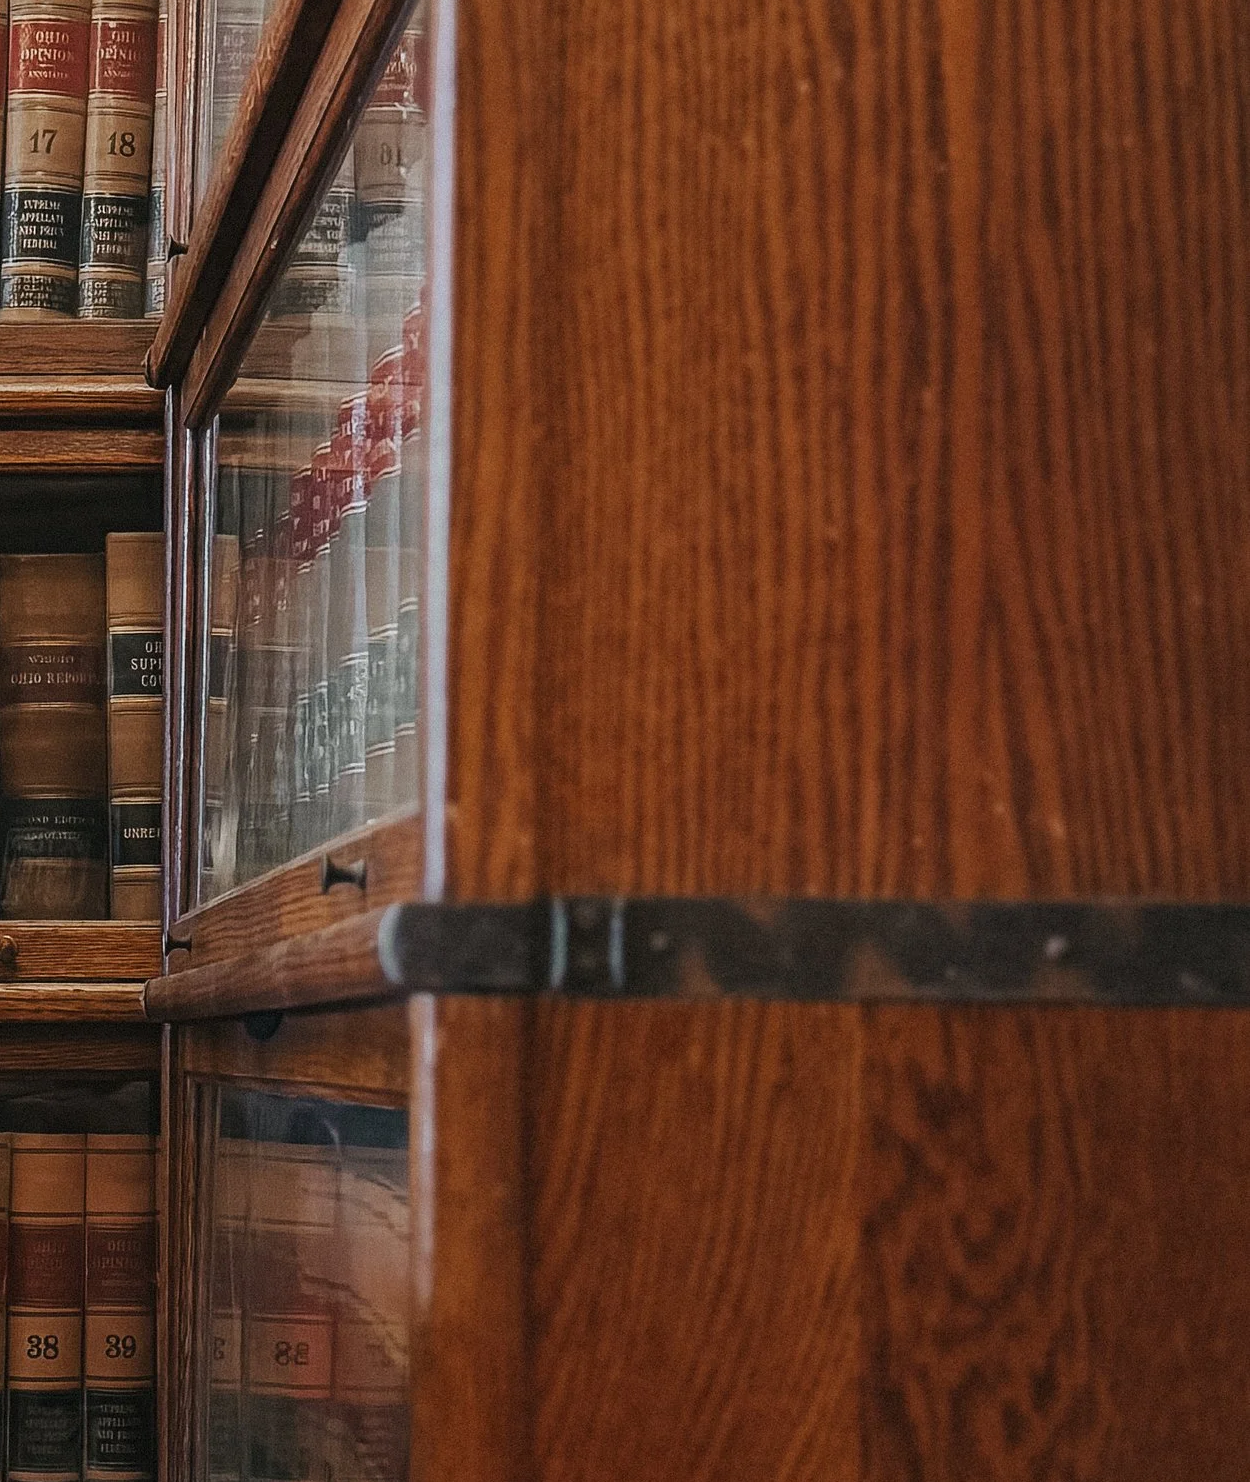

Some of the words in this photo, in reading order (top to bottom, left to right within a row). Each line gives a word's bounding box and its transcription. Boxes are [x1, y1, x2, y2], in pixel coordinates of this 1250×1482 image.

[36, 30, 70, 44] OHIO
[28, 129, 58, 154] 17
[106, 131, 136, 157] 18
[26, 1335, 59, 1360] 38
[104, 1333, 138, 1359] 39
